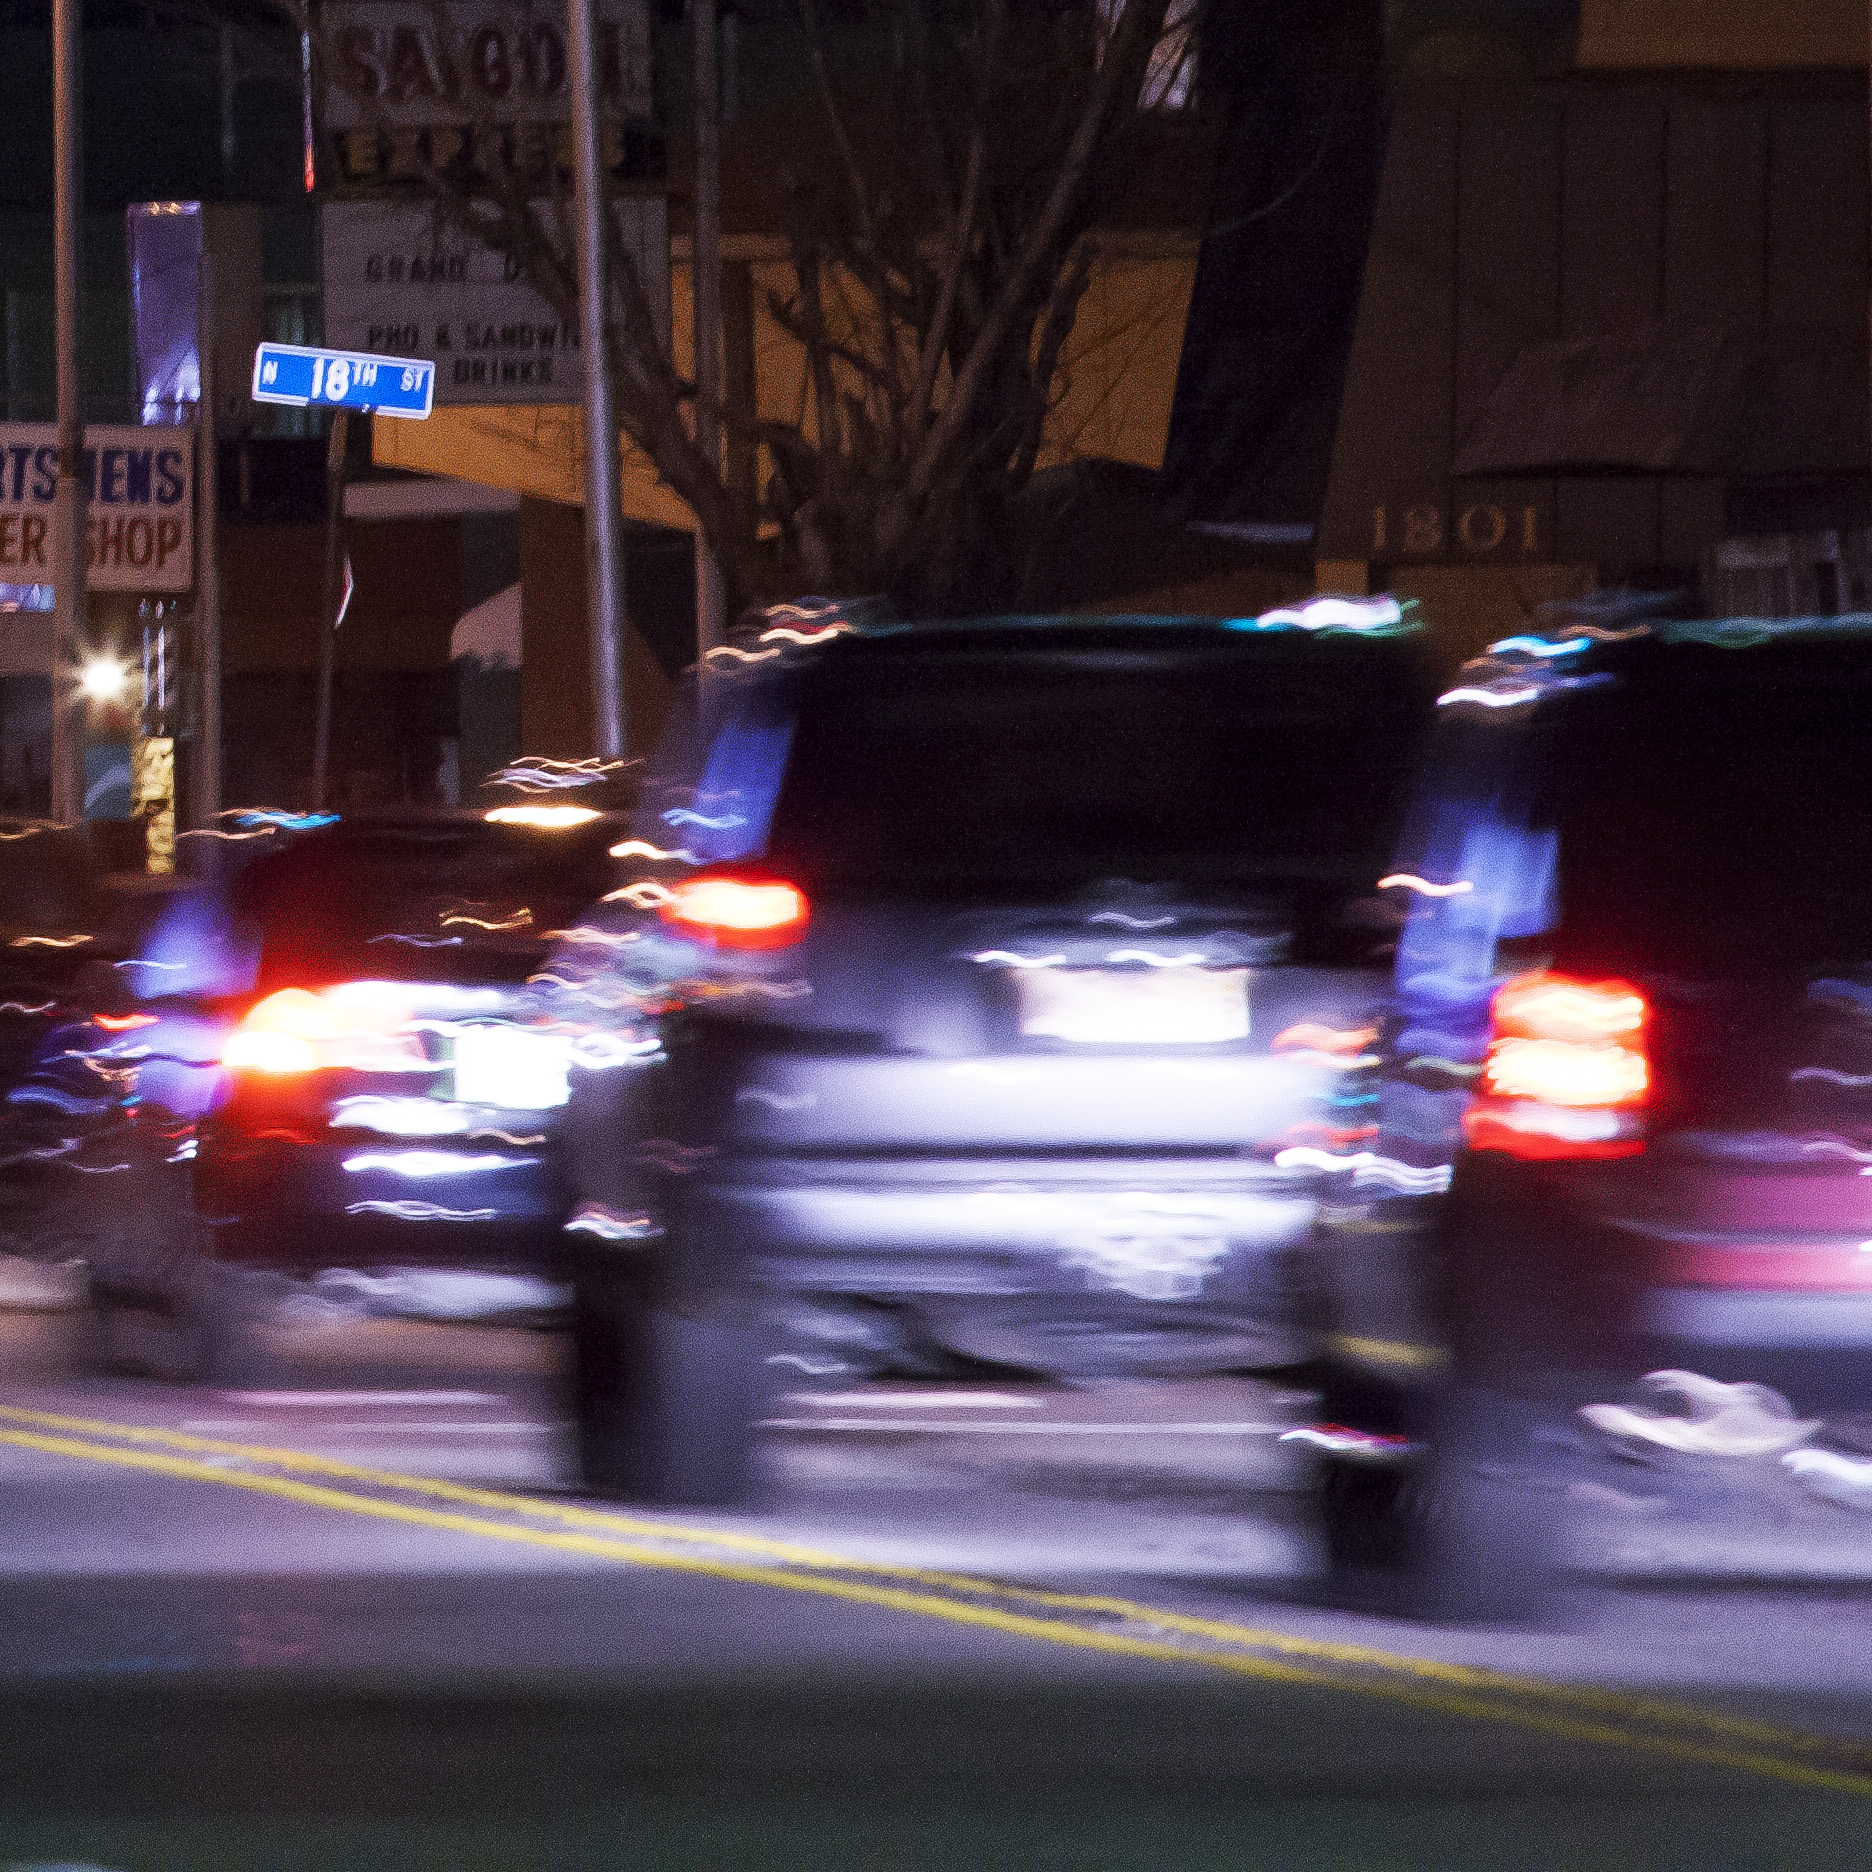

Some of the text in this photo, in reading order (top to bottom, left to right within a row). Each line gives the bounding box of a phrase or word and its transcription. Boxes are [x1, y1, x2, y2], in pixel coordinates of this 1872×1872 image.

[367, 324, 420, 353] PHO
[262, 356, 425, 402] N 18TH ST
[453, 357, 554, 385] DRINKS
[1373, 504, 1537, 553] 1801
